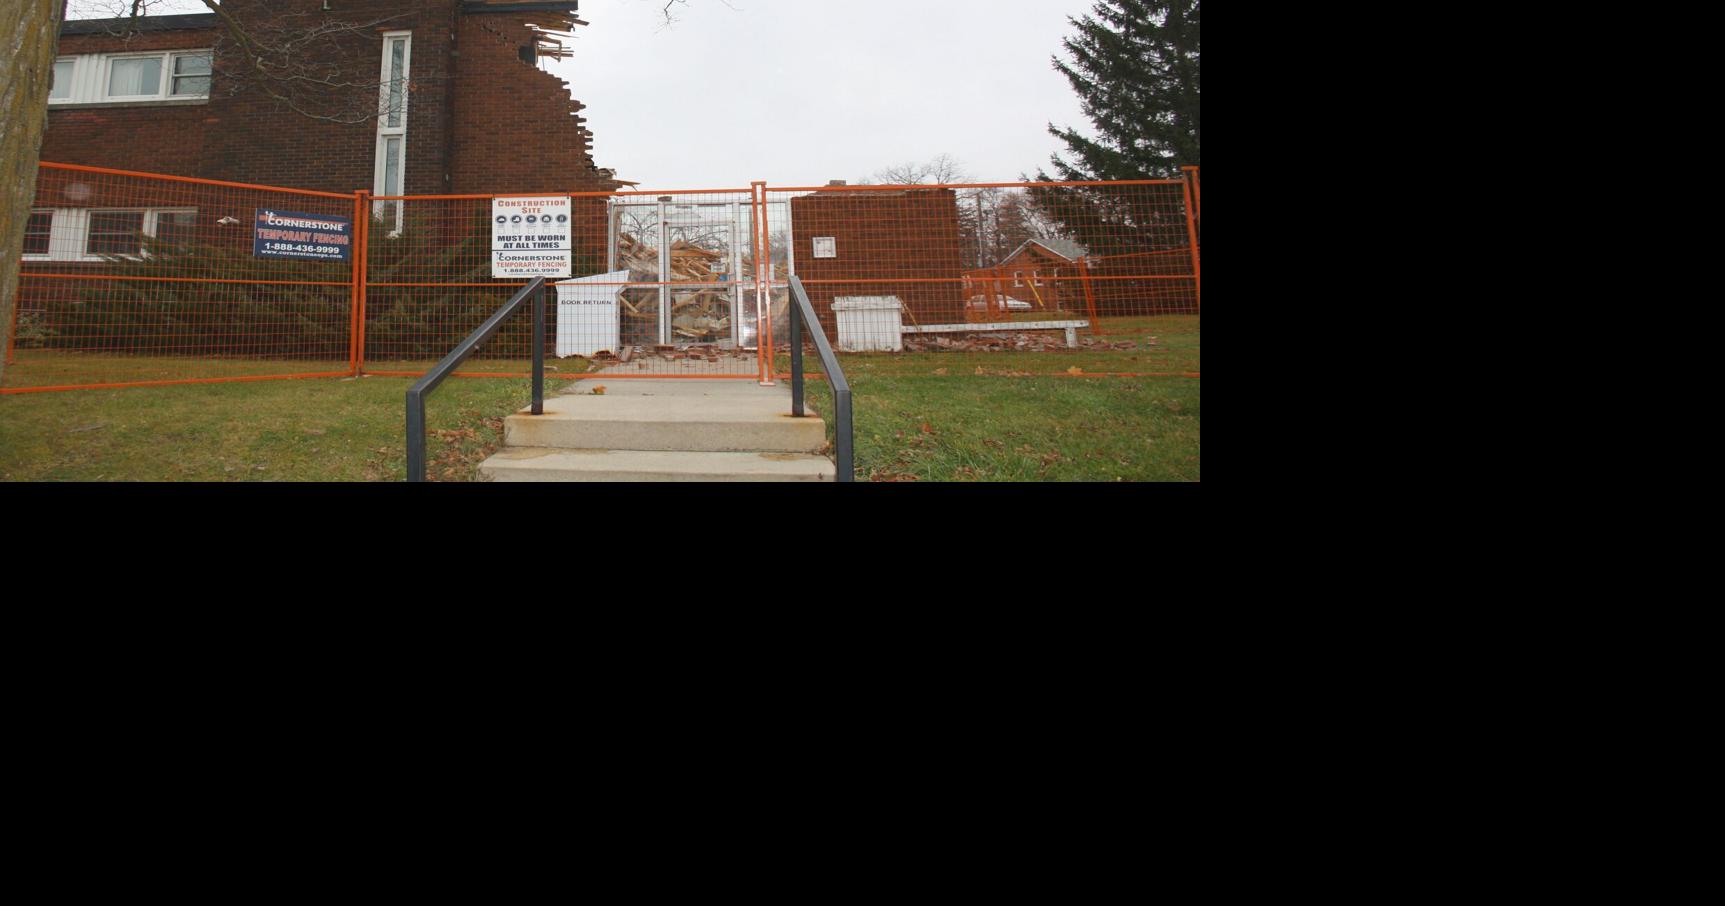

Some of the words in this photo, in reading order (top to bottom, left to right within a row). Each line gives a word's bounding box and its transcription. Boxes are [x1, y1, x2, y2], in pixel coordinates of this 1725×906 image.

[267, 216, 343, 231] CORNERSTONE
[257, 228, 311, 242] TEMPORARY
[312, 232, 349, 245] FENCING
[264, 242, 339, 254] 1-888-436-9999
